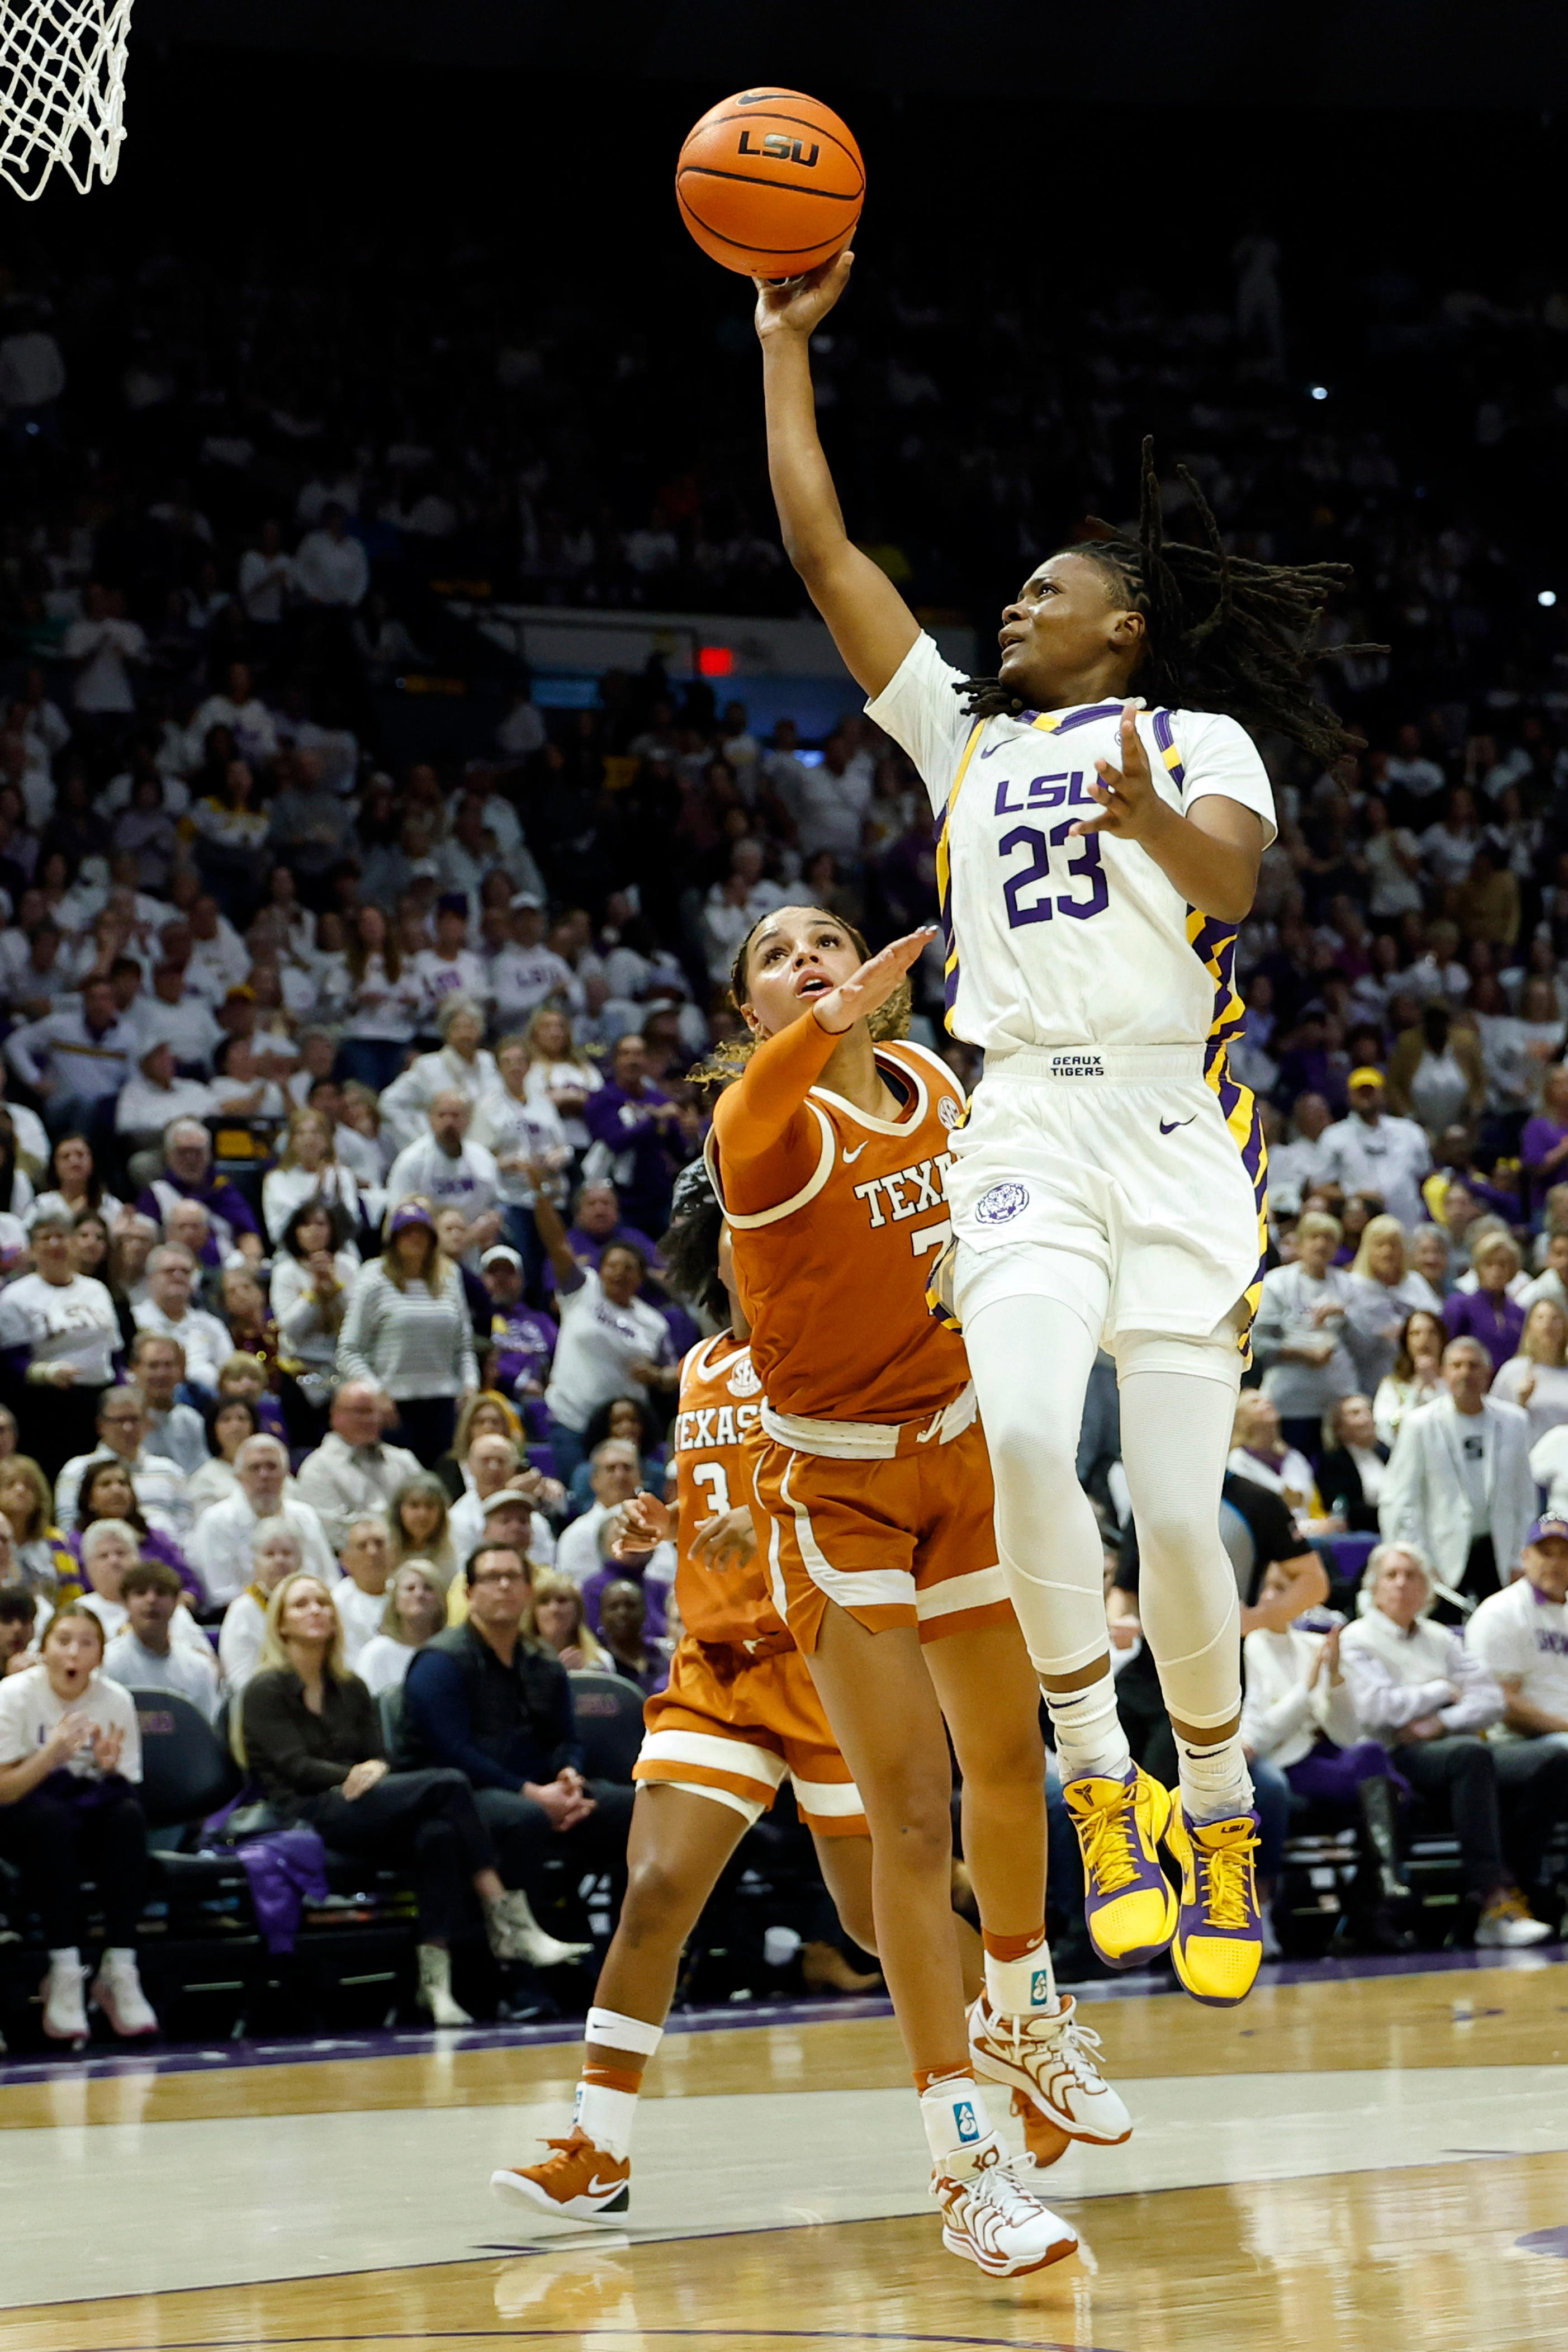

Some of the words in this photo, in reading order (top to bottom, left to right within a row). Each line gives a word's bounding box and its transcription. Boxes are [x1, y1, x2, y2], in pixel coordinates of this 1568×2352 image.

[738, 131, 819, 167] LSU
[994, 771, 1109, 816] LSU
[999, 818, 1109, 929] 23
[1050, 1067, 1105, 1076] TIGERS
[1053, 1056, 1101, 1065] GEAUX
[693, 1462, 731, 1517] 3
[1221, 1823, 1245, 1834] LSU
